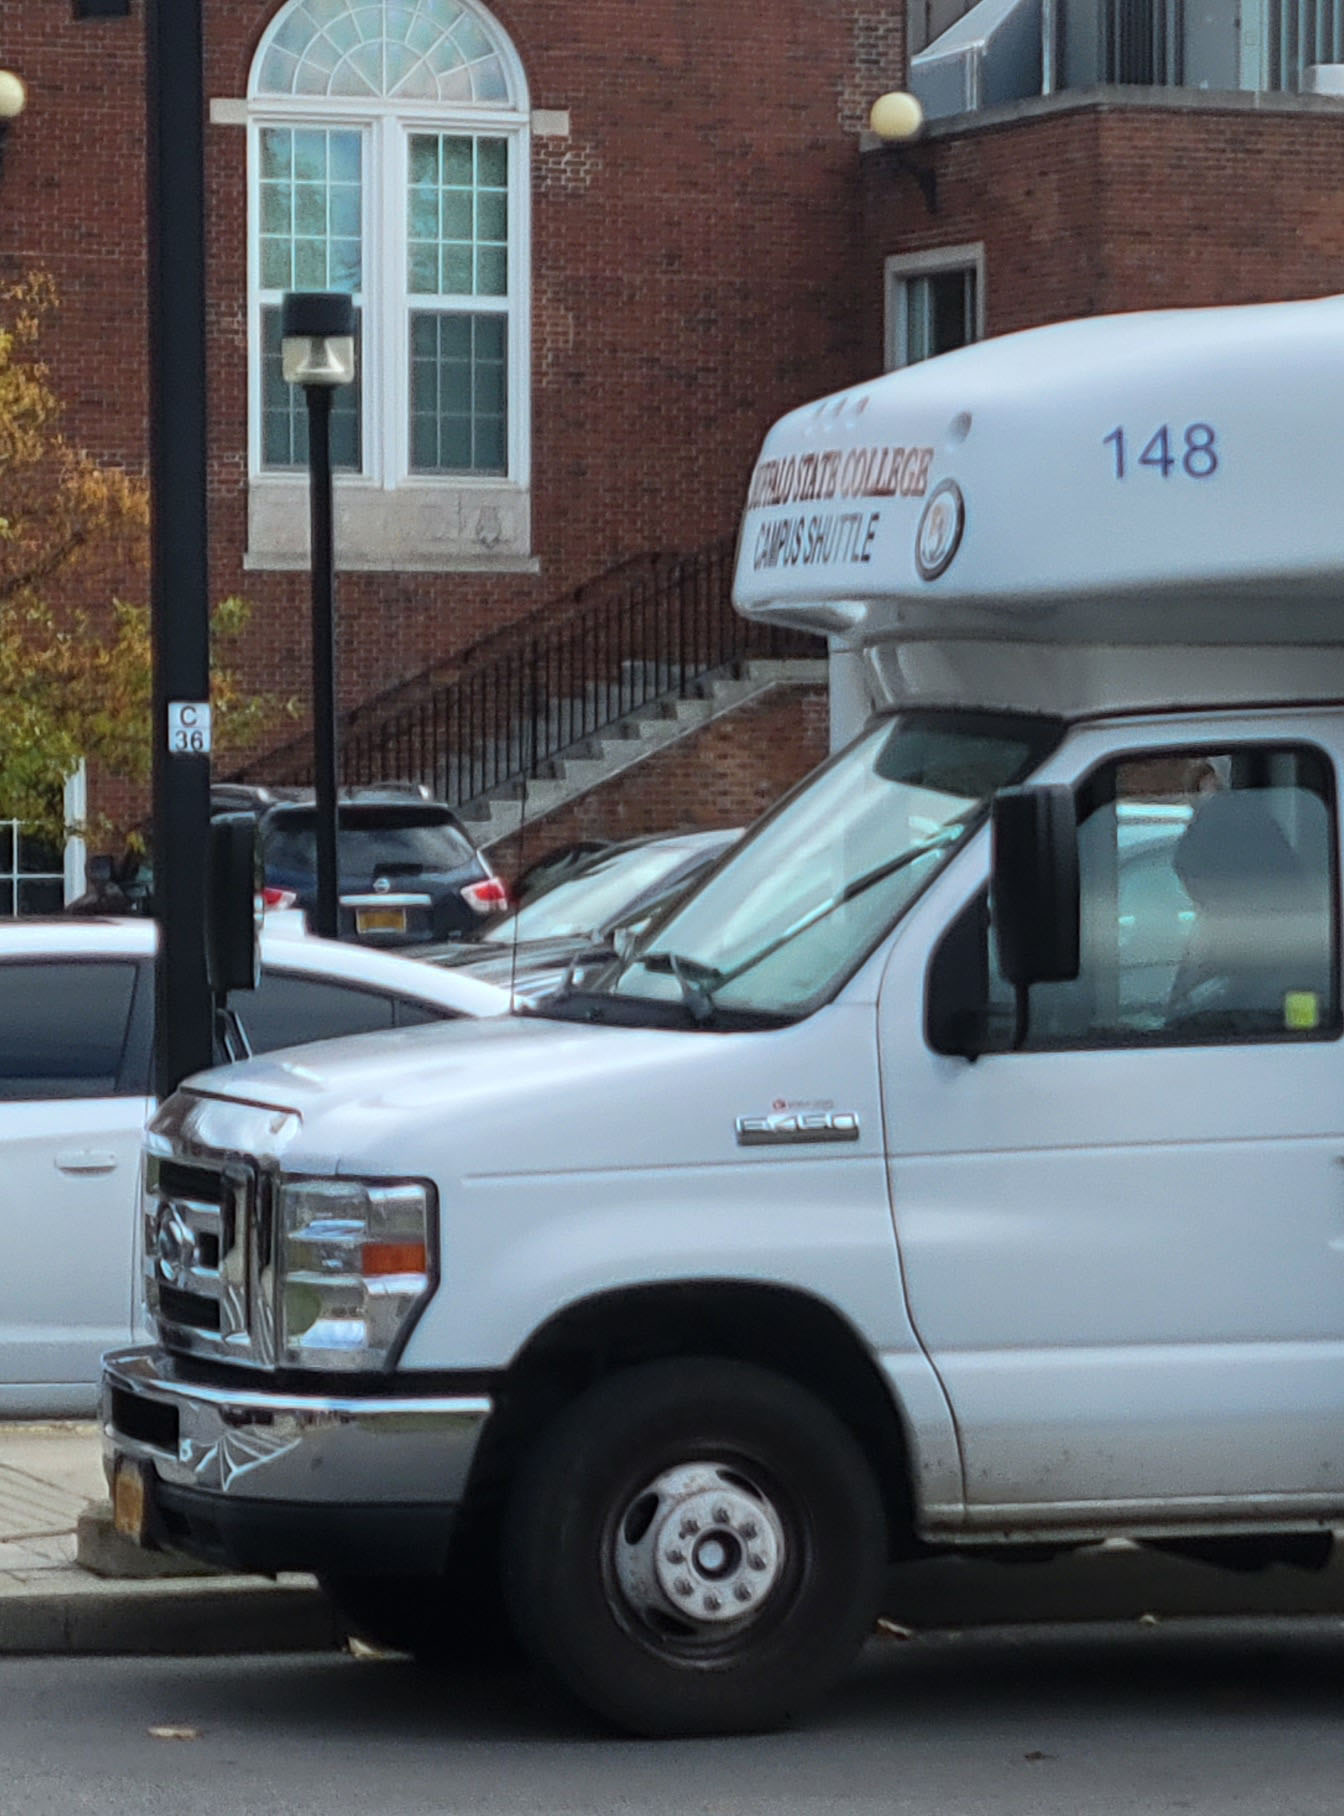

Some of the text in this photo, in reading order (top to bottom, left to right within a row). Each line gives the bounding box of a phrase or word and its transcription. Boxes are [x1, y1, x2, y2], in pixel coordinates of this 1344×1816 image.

[840, 447, 935, 498] COLLEGE
[1102, 423, 1218, 479] 148
[754, 512, 881, 572] CAMPUS SHUTTLE
[175, 730, 204, 753] 36
[180, 705, 198, 728] C
